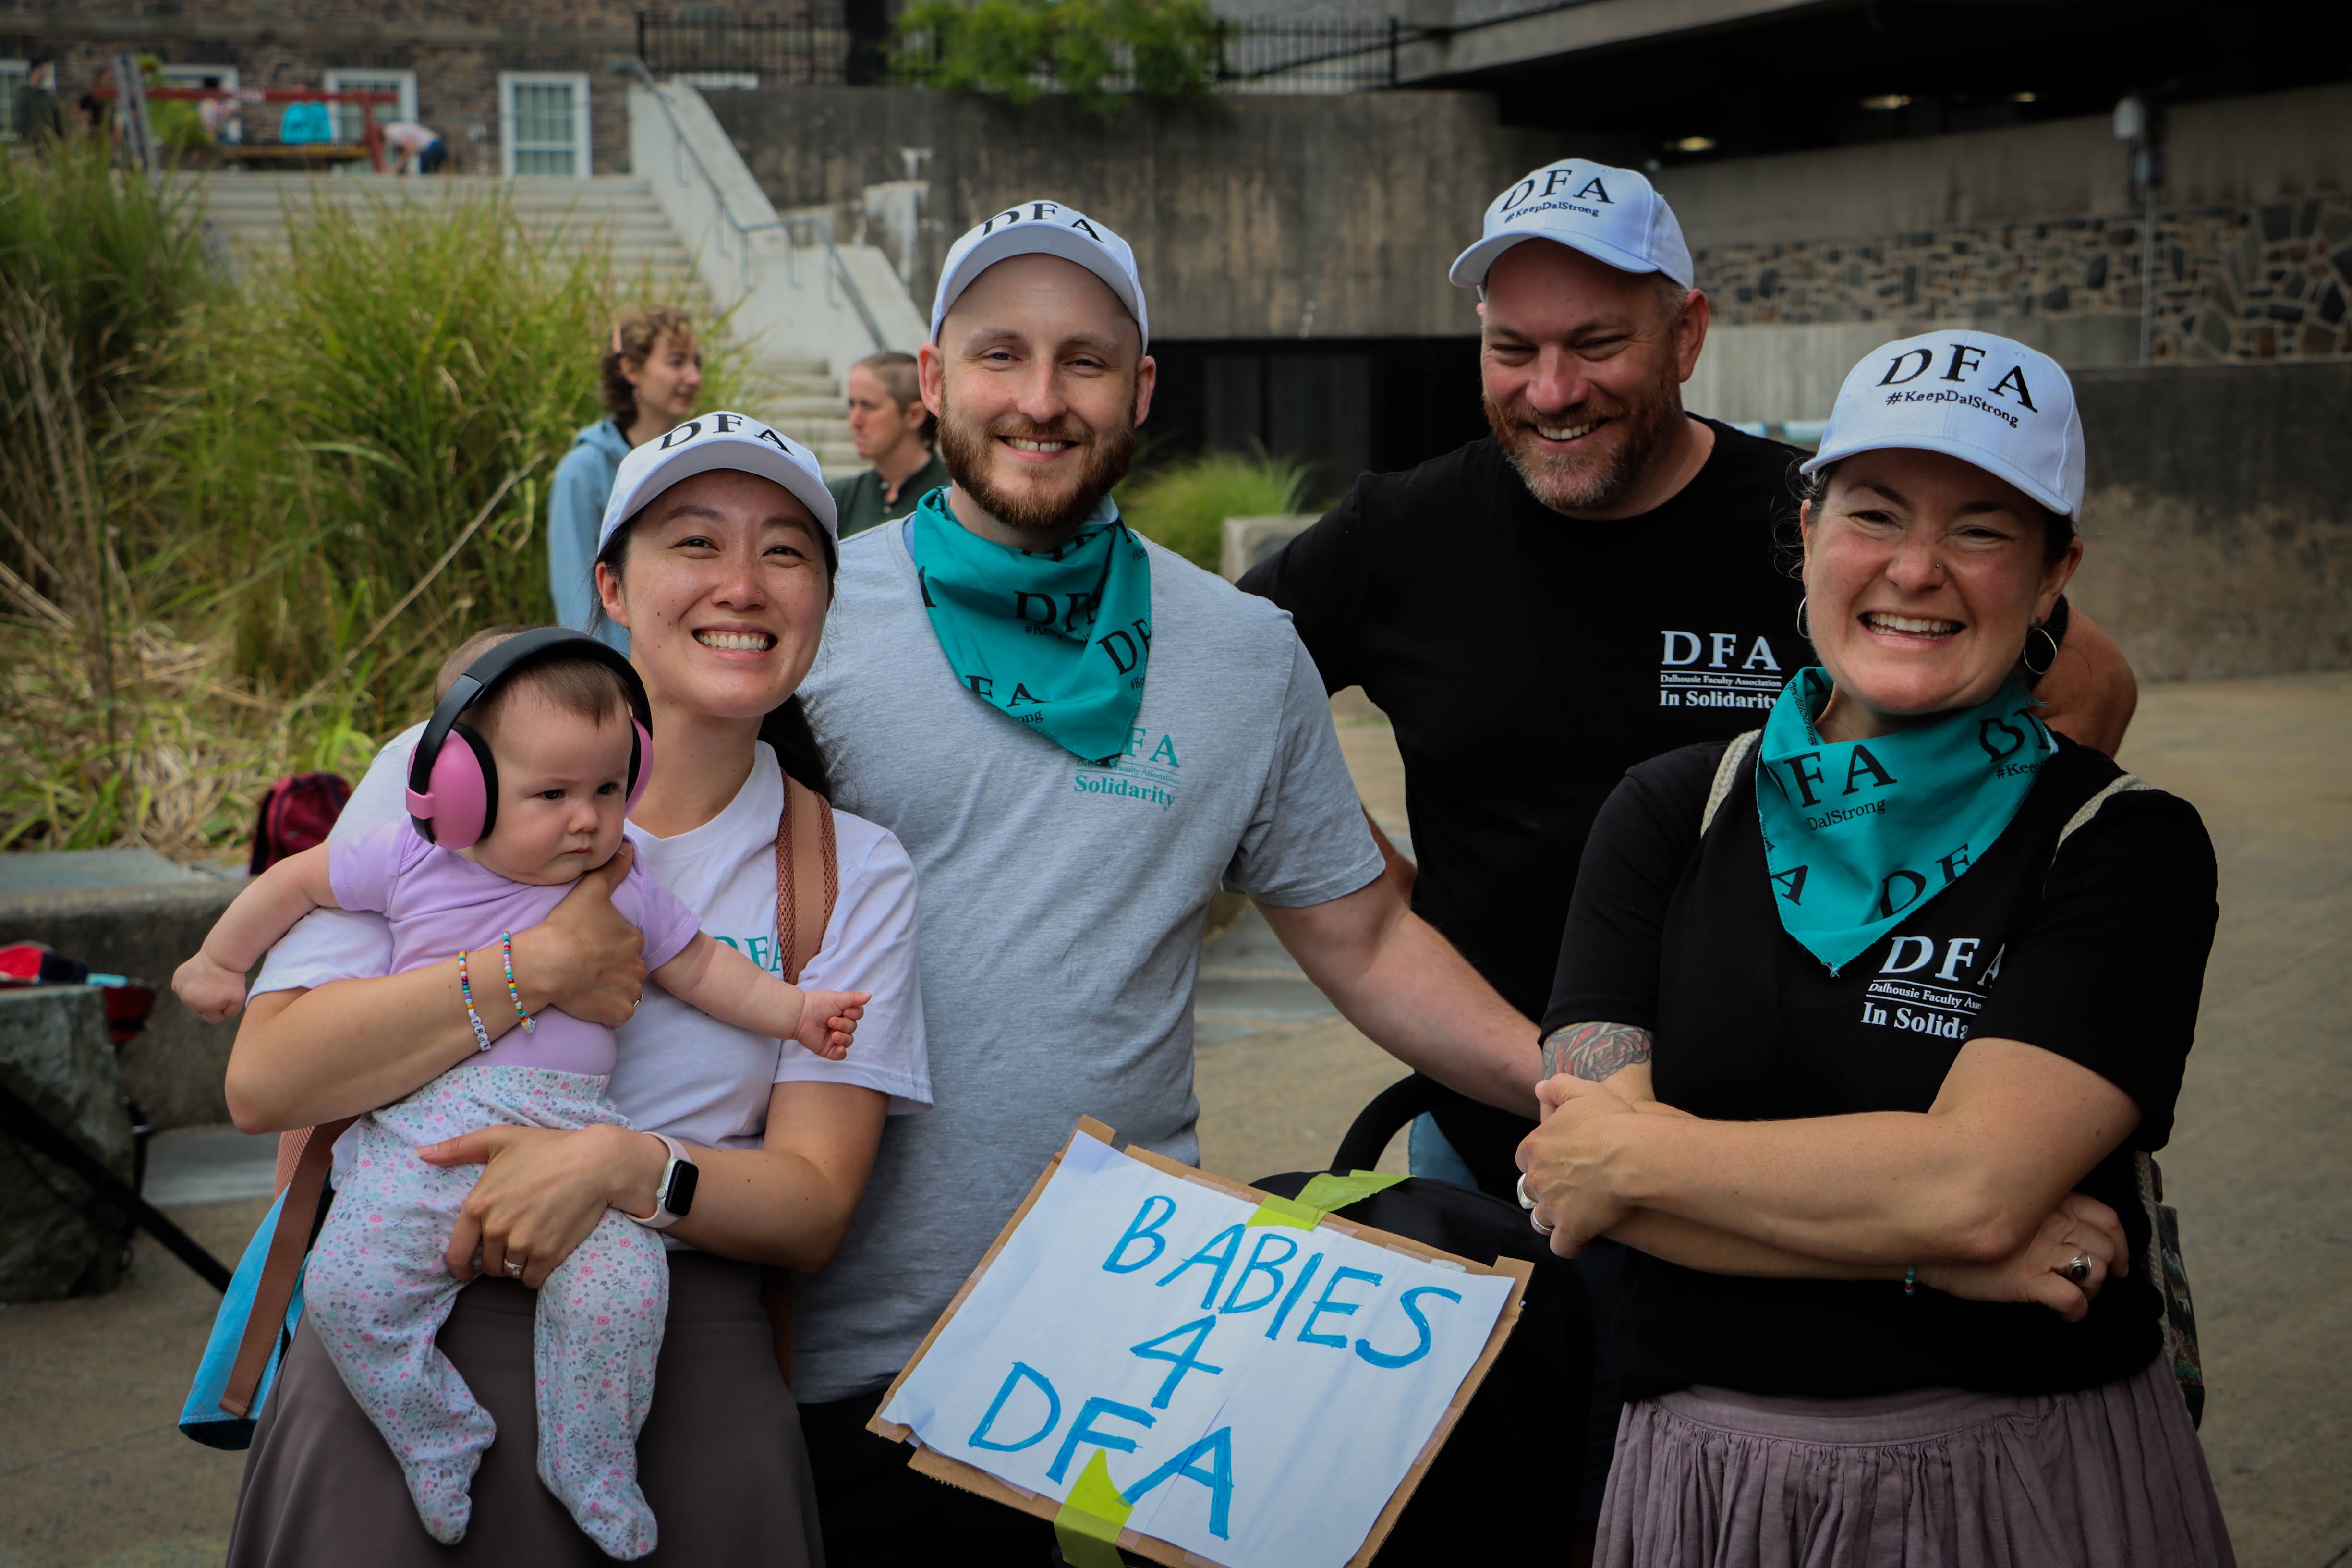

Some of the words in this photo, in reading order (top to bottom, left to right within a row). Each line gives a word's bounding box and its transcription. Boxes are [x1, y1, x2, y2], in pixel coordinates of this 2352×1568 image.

[1499, 169, 1615, 213] DFA
[1504, 202, 1600, 224] #KeepDalStrong
[1876, 343, 2038, 413] DFA
[1885, 389, 2019, 428] #KeepDalStrong
[657, 414, 795, 456] DFA
[1661, 630, 1782, 671] DFA
[1659, 690, 1680, 706] In
[1660, 674, 1702, 683] Dalhousie
[1703, 676, 1734, 686] Faculty
[1734, 678, 1782, 687] Association
[1074, 775, 1176, 811] Solidarity
[1141, 769, 1179, 784] Association
[1766, 744, 1897, 808] FA
[1879, 936, 2005, 988] DFA
[1868, 983, 1920, 998] Dalhousie
[1922, 989, 1963, 1009] Faculty
[1964, 997, 1982, 1010] Asso
[1860, 1002, 1888, 1026] In
[1894, 1007, 1969, 1040] Solida
[1101, 1195, 1462, 1370] BABIES
[1130, 1314, 1224, 1410] 4
[968, 1361, 1235, 1541] DFA
